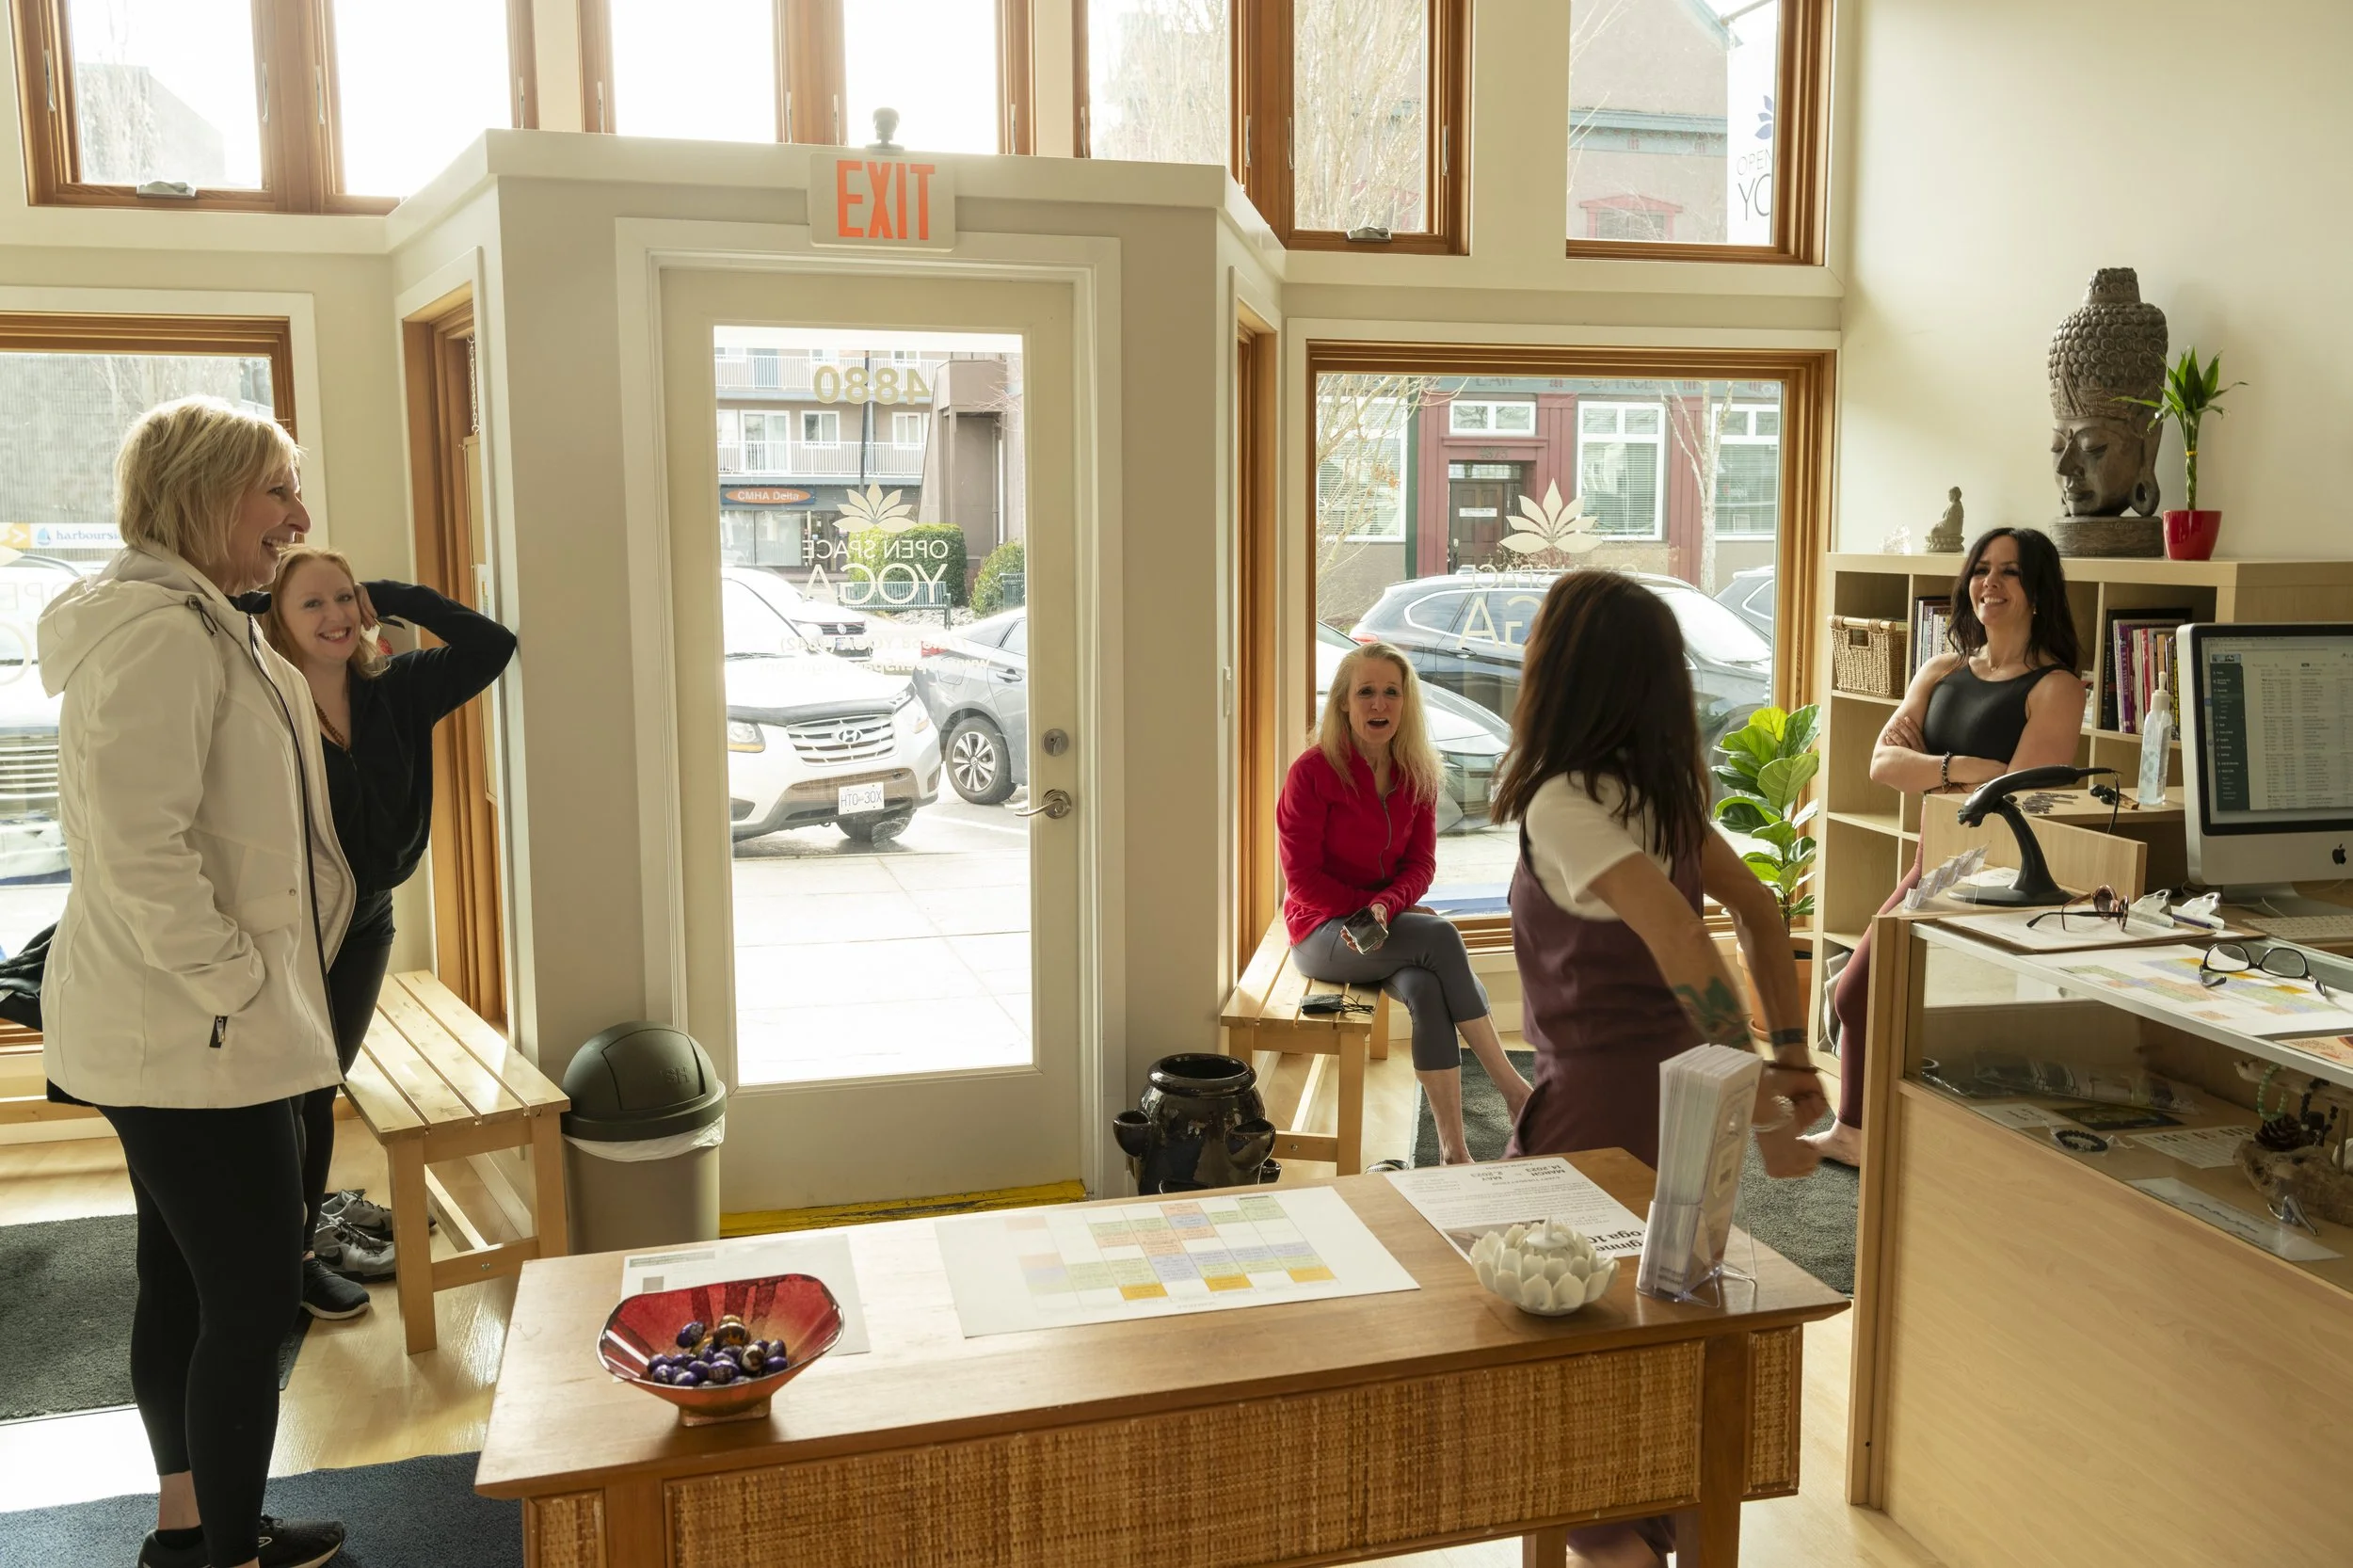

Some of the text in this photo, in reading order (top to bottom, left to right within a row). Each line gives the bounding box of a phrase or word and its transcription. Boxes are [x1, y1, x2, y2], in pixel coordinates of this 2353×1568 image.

[836, 159, 936, 242] EXIT
[1737, 172, 1771, 222] YO
[737, 490, 800, 502] CMHA Delta
[1606, 1229, 1645, 1240] oga
